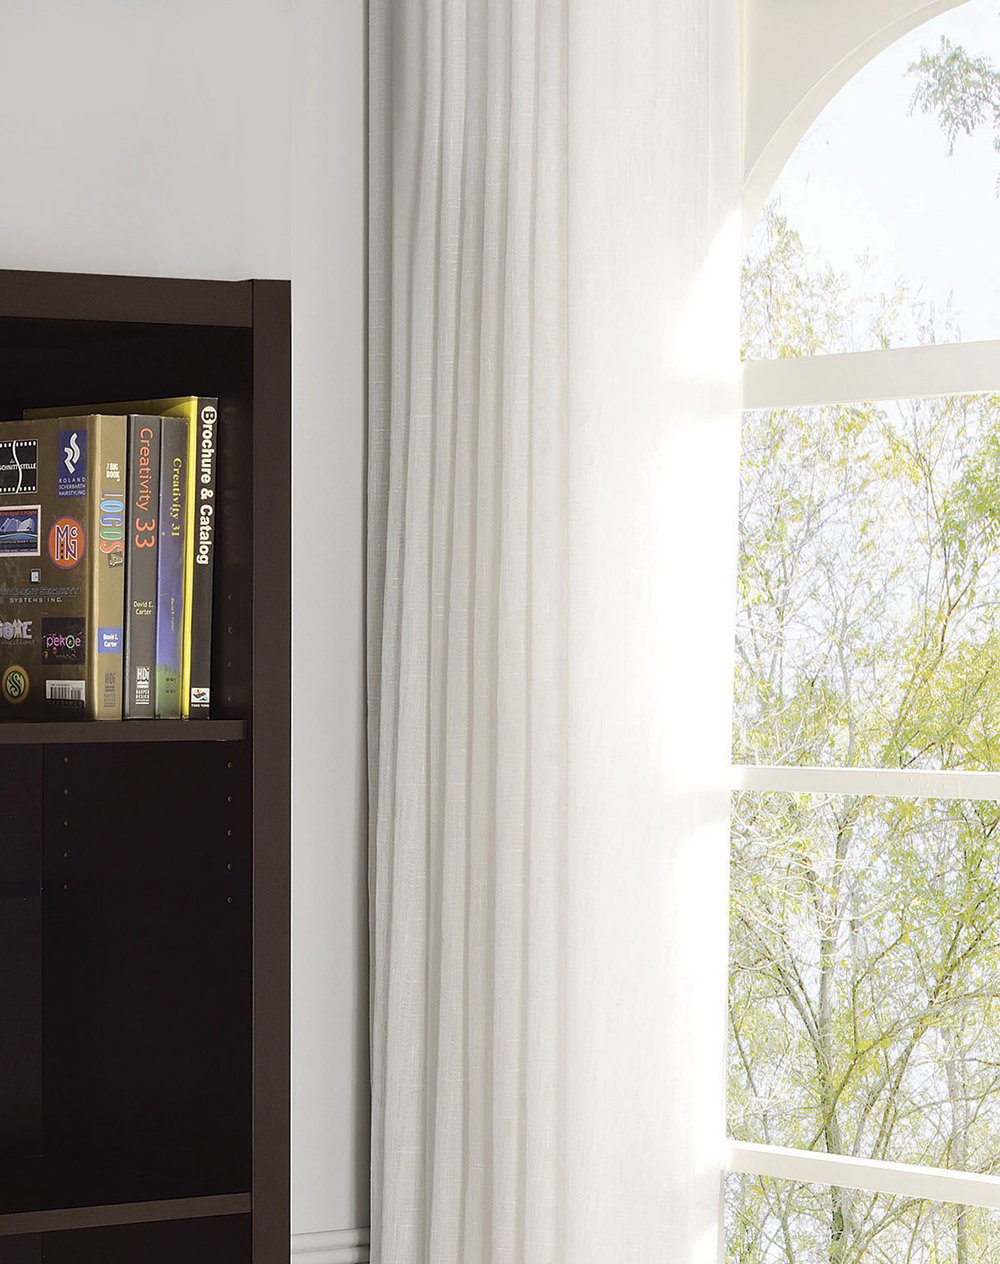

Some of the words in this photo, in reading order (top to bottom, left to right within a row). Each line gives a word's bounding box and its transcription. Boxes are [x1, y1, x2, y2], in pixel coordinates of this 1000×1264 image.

[200, 405, 218, 484] Brochure
[136, 427, 153, 512] Creativity
[170, 458, 182, 520] Creativity
[200, 488, 214, 501] &
[134, 517, 156, 549] 33
[171, 523, 181, 536] 31
[197, 504, 214, 565] Catalog
[133, 600, 148, 608] David
[135, 608, 152, 616] Carter
